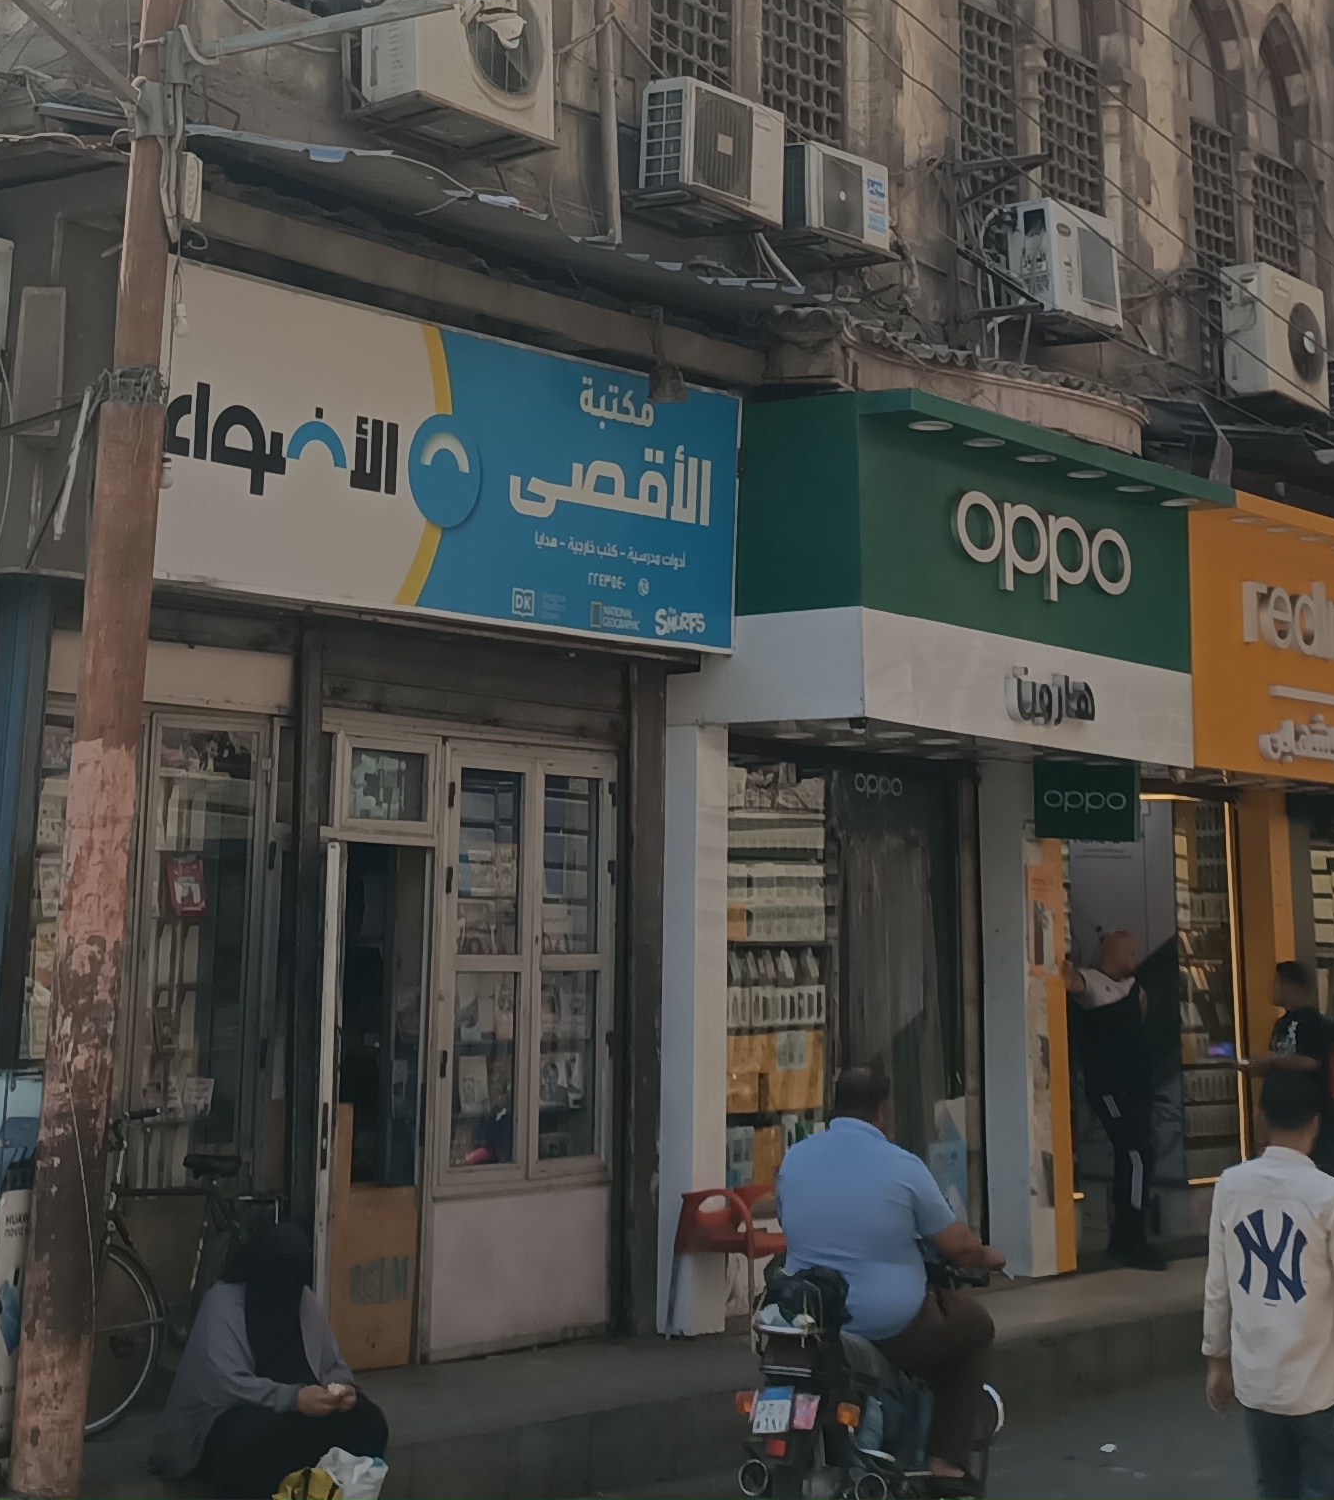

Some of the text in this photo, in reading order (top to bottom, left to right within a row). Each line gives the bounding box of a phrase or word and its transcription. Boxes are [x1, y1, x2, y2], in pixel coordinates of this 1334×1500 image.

[579, 376, 655, 430] مكتبة
[509, 445, 712, 527] الأقصى
[567, 537, 596, 556] خارجية
[597, 543, 618, 559] كتب
[627, 546, 661, 566] مدرسية
[1233, 1208, 1309, 1305] NY
